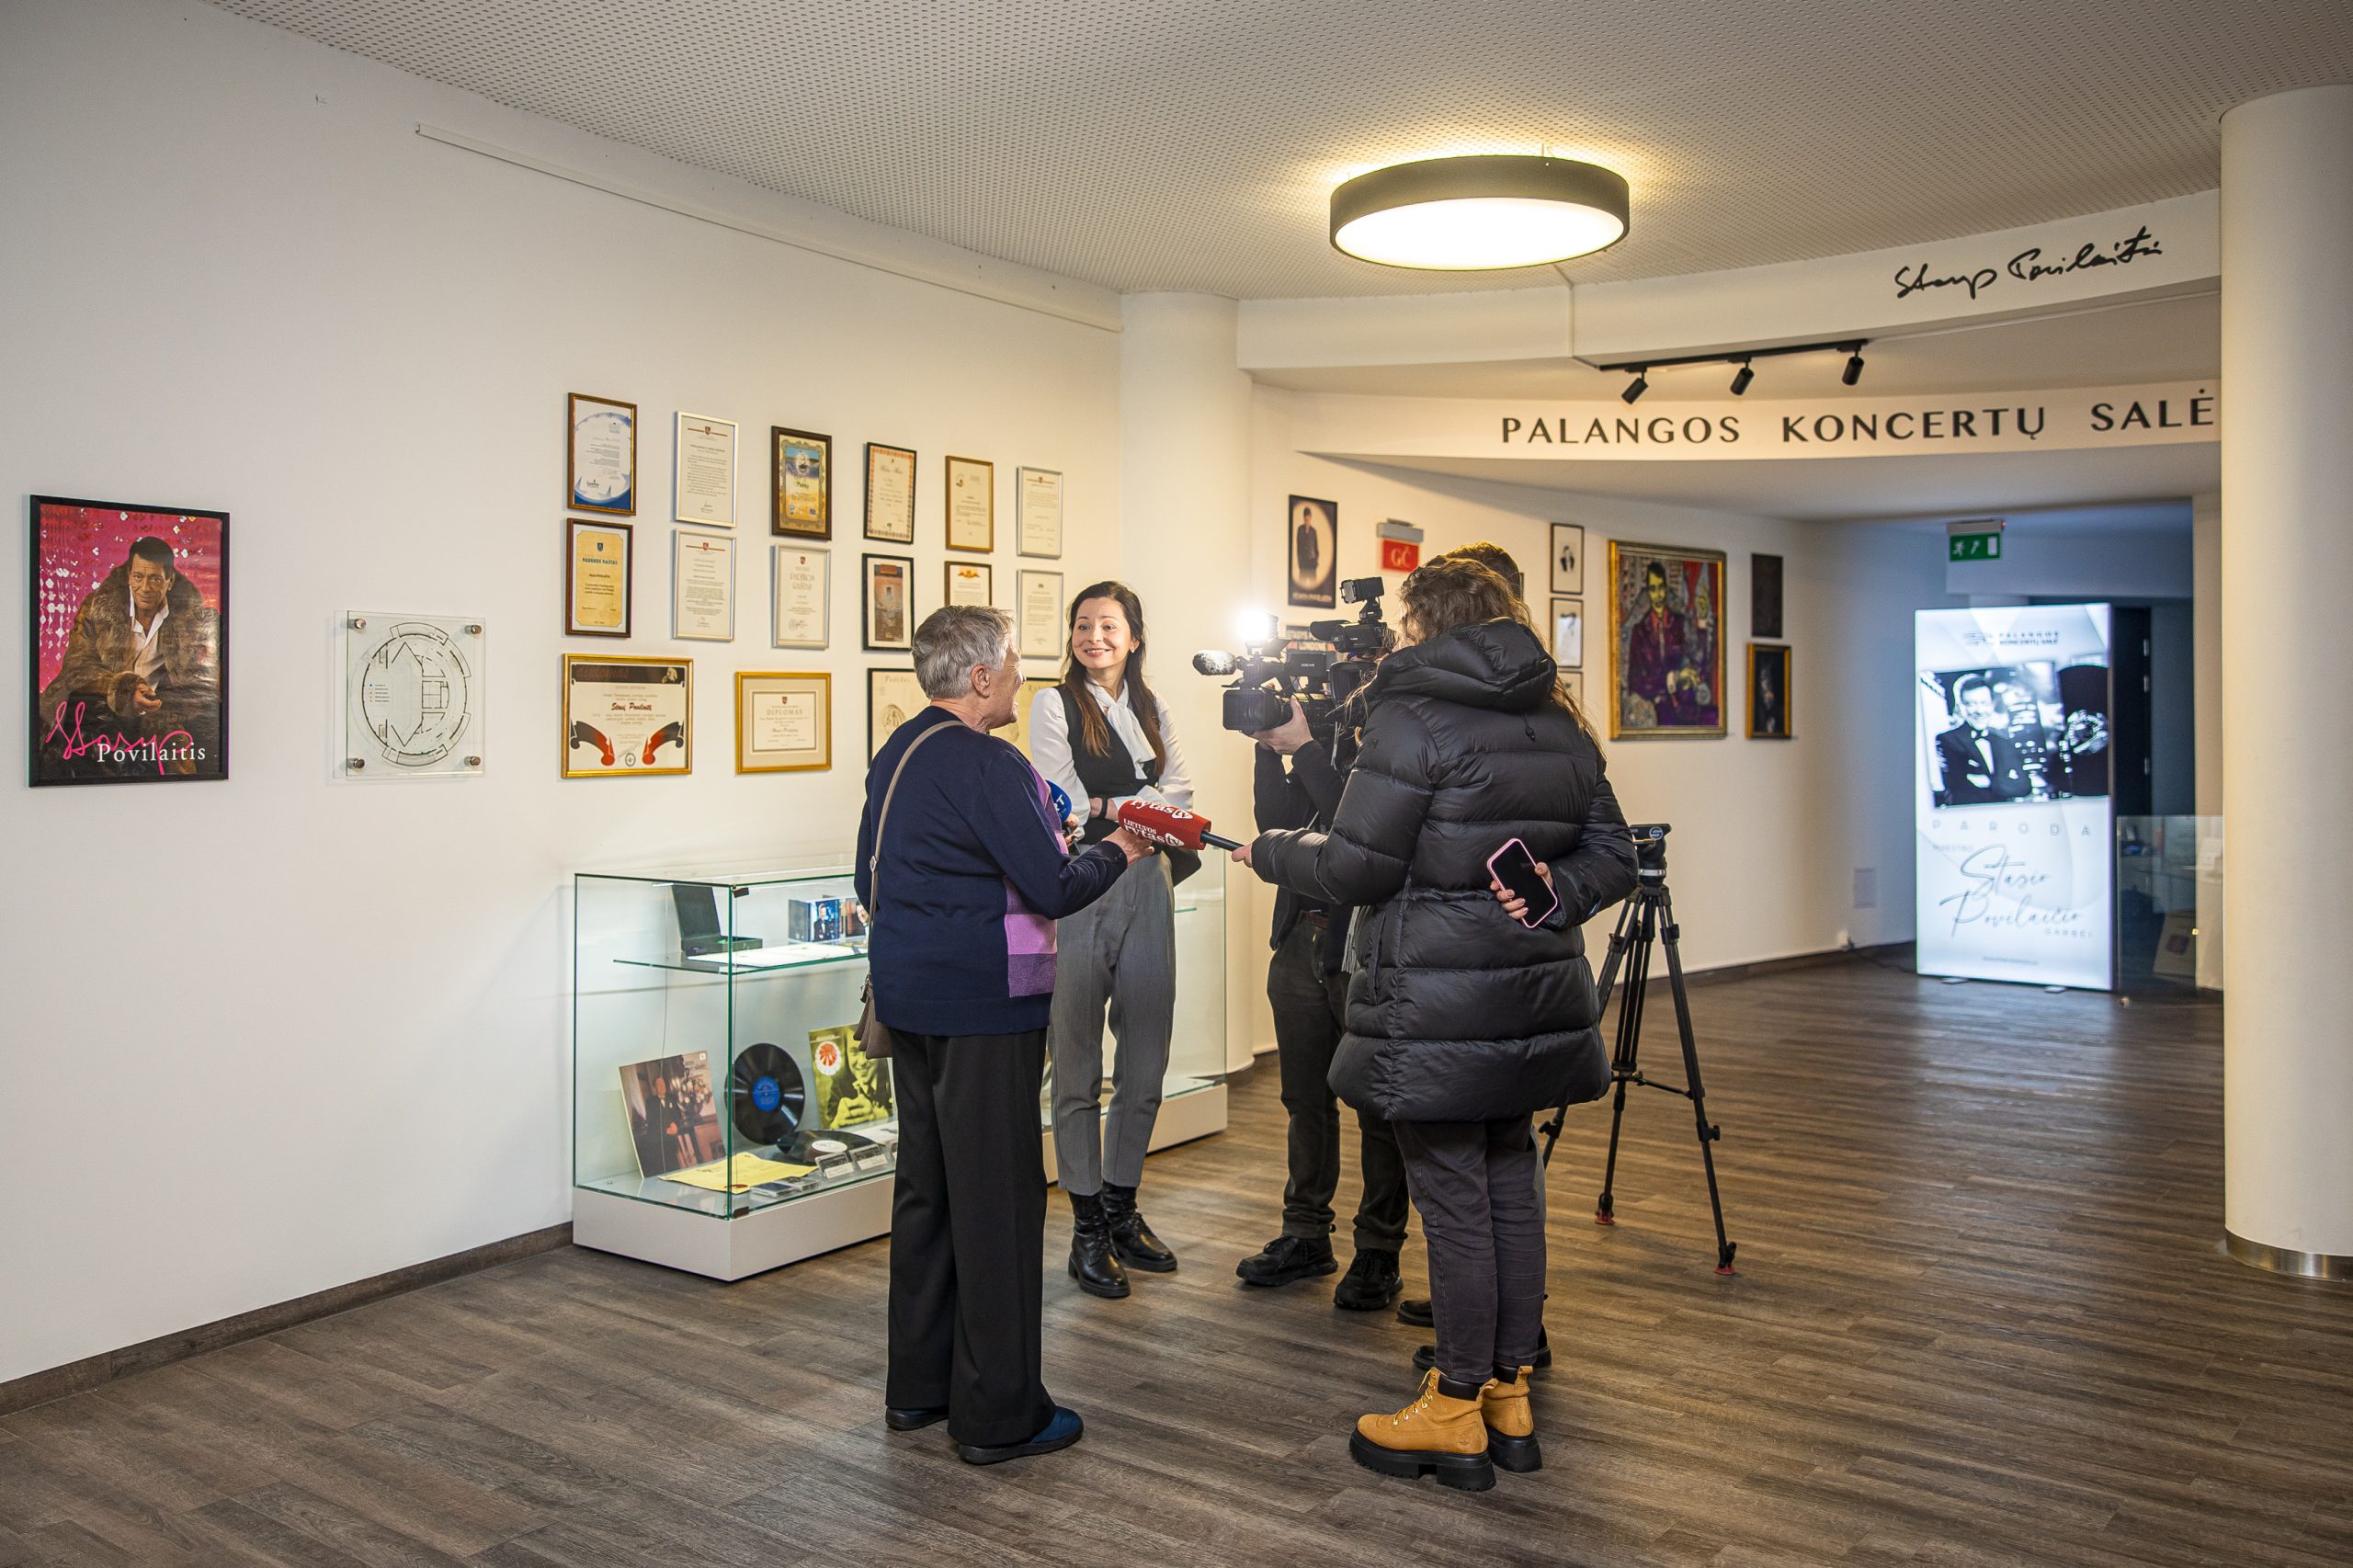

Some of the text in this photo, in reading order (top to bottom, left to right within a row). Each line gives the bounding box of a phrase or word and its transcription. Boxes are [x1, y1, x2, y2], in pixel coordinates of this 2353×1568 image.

[1502, 388, 2214, 444] PALANGOS KONCERTŲ SALĖ
[97, 742, 206, 763] Povilaitis
[1123, 818, 1157, 835] LIETUVOS
[1124, 824, 1165, 844] rytas
[1932, 820, 2090, 836] PARODA
